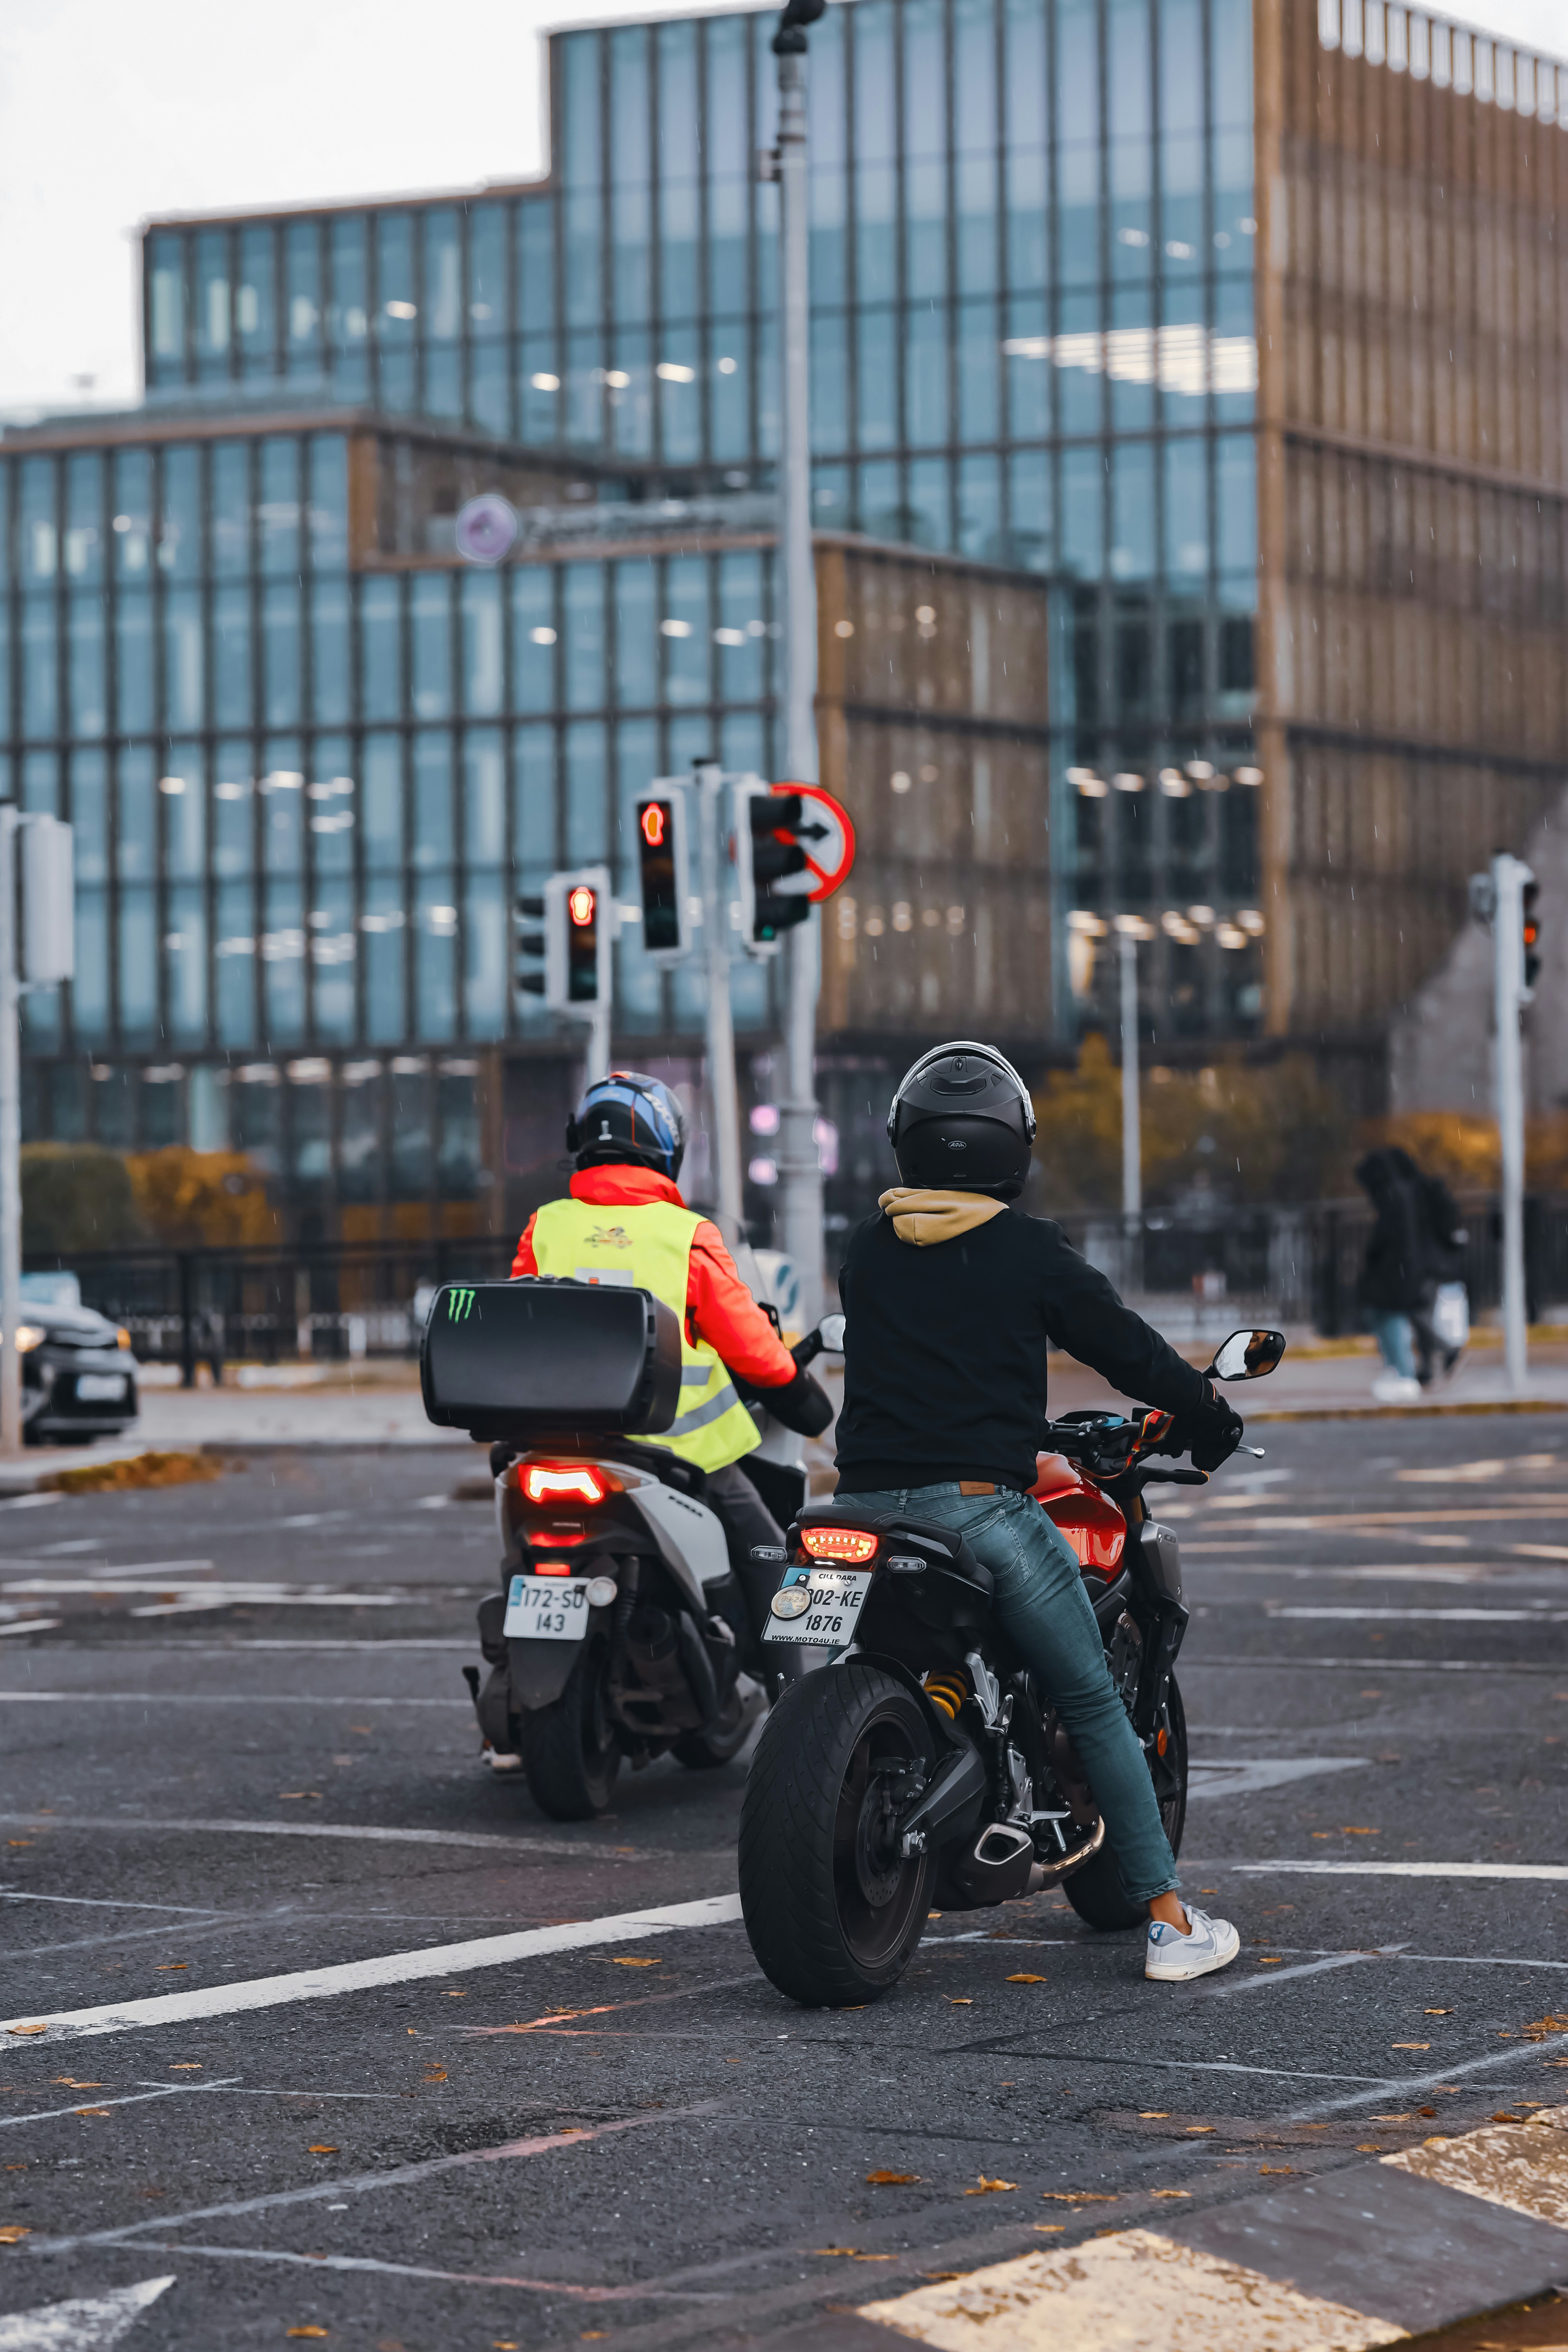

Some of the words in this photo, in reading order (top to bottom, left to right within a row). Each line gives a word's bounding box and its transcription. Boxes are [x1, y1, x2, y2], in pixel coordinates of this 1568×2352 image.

[537, 1613, 565, 1631] 143
[805, 1614, 843, 1632] 1876
[772, 1635, 840, 1644] WWW.MOTO4U.IE
